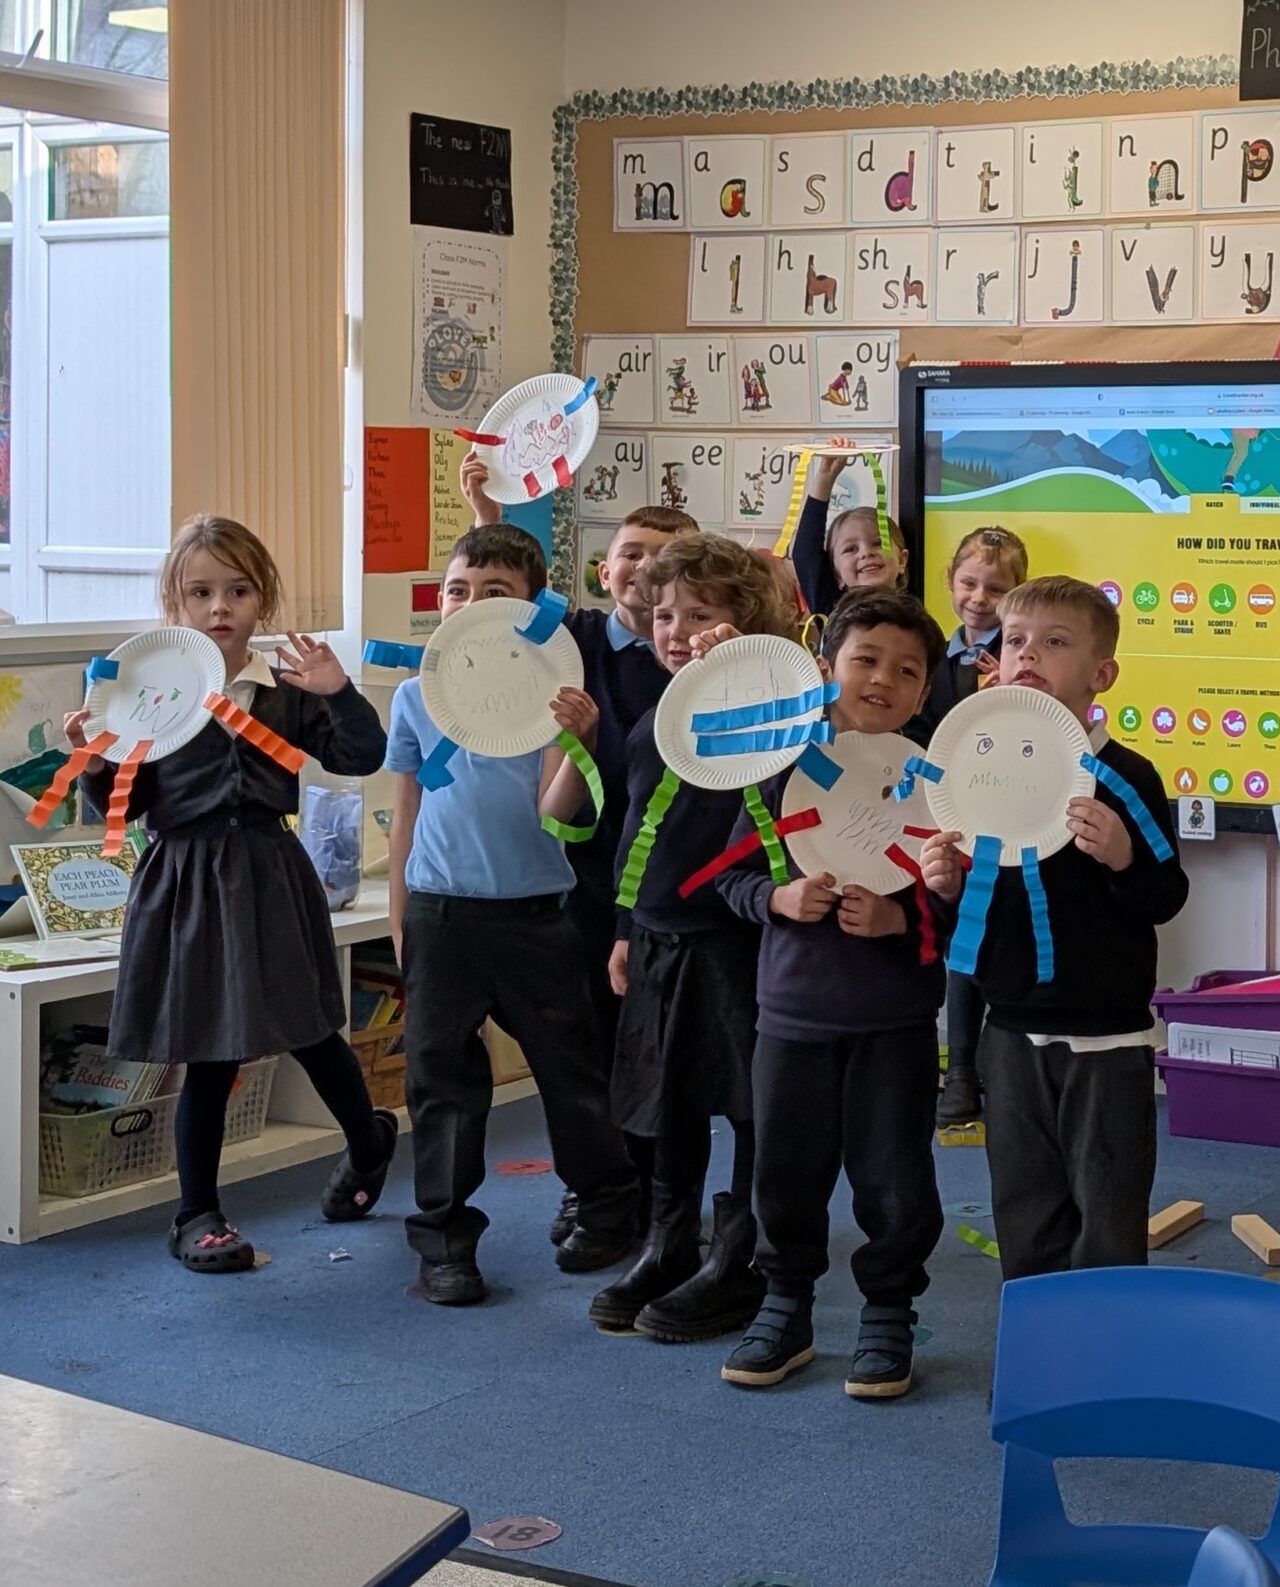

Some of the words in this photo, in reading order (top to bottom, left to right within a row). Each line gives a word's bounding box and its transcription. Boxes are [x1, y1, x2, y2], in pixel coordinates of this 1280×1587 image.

[420, 123, 443, 148] The
[1118, 134, 1137, 157] n
[1210, 127, 1229, 161] p
[857, 139, 875, 172] d
[945, 142, 956, 168] t
[1029, 134, 1037, 164] i
[623, 153, 646, 174] m
[694, 151, 711, 172] a
[777, 151, 789, 173] s
[420, 167, 444, 185] This
[701, 241, 708, 273] l
[777, 239, 794, 271] h
[857, 238, 889, 271] sh
[945, 249, 957, 270] r
[1027, 238, 1040, 279] j
[1120, 239, 1138, 262] v
[1210, 235, 1226, 268] y
[615, 345, 652, 376] air
[708, 344, 727, 373] ir
[769, 343, 806, 365] ou
[856, 342, 891, 373] oy
[612, 442, 643, 475] ay
[691, 445, 723, 466] ee
[1177, 538, 1202, 550] HOW
[1207, 538, 1225, 550] DID
[1229, 539, 1250, 550] YOU
[1137, 618, 1155, 626] CYCLE
[1173, 619, 1189, 627] PARK
[1207, 620, 1233, 628] SCOOTER
[1255, 621, 1267, 629] BUS
[53, 871, 82, 881] EACH
[84, 869, 119, 879] PEACH
[60, 881, 87, 891] PEAR
[90, 879, 120, 889] PLUM
[75, 1066, 129, 1091] Baddies
[488, 1524, 541, 1541] 18
